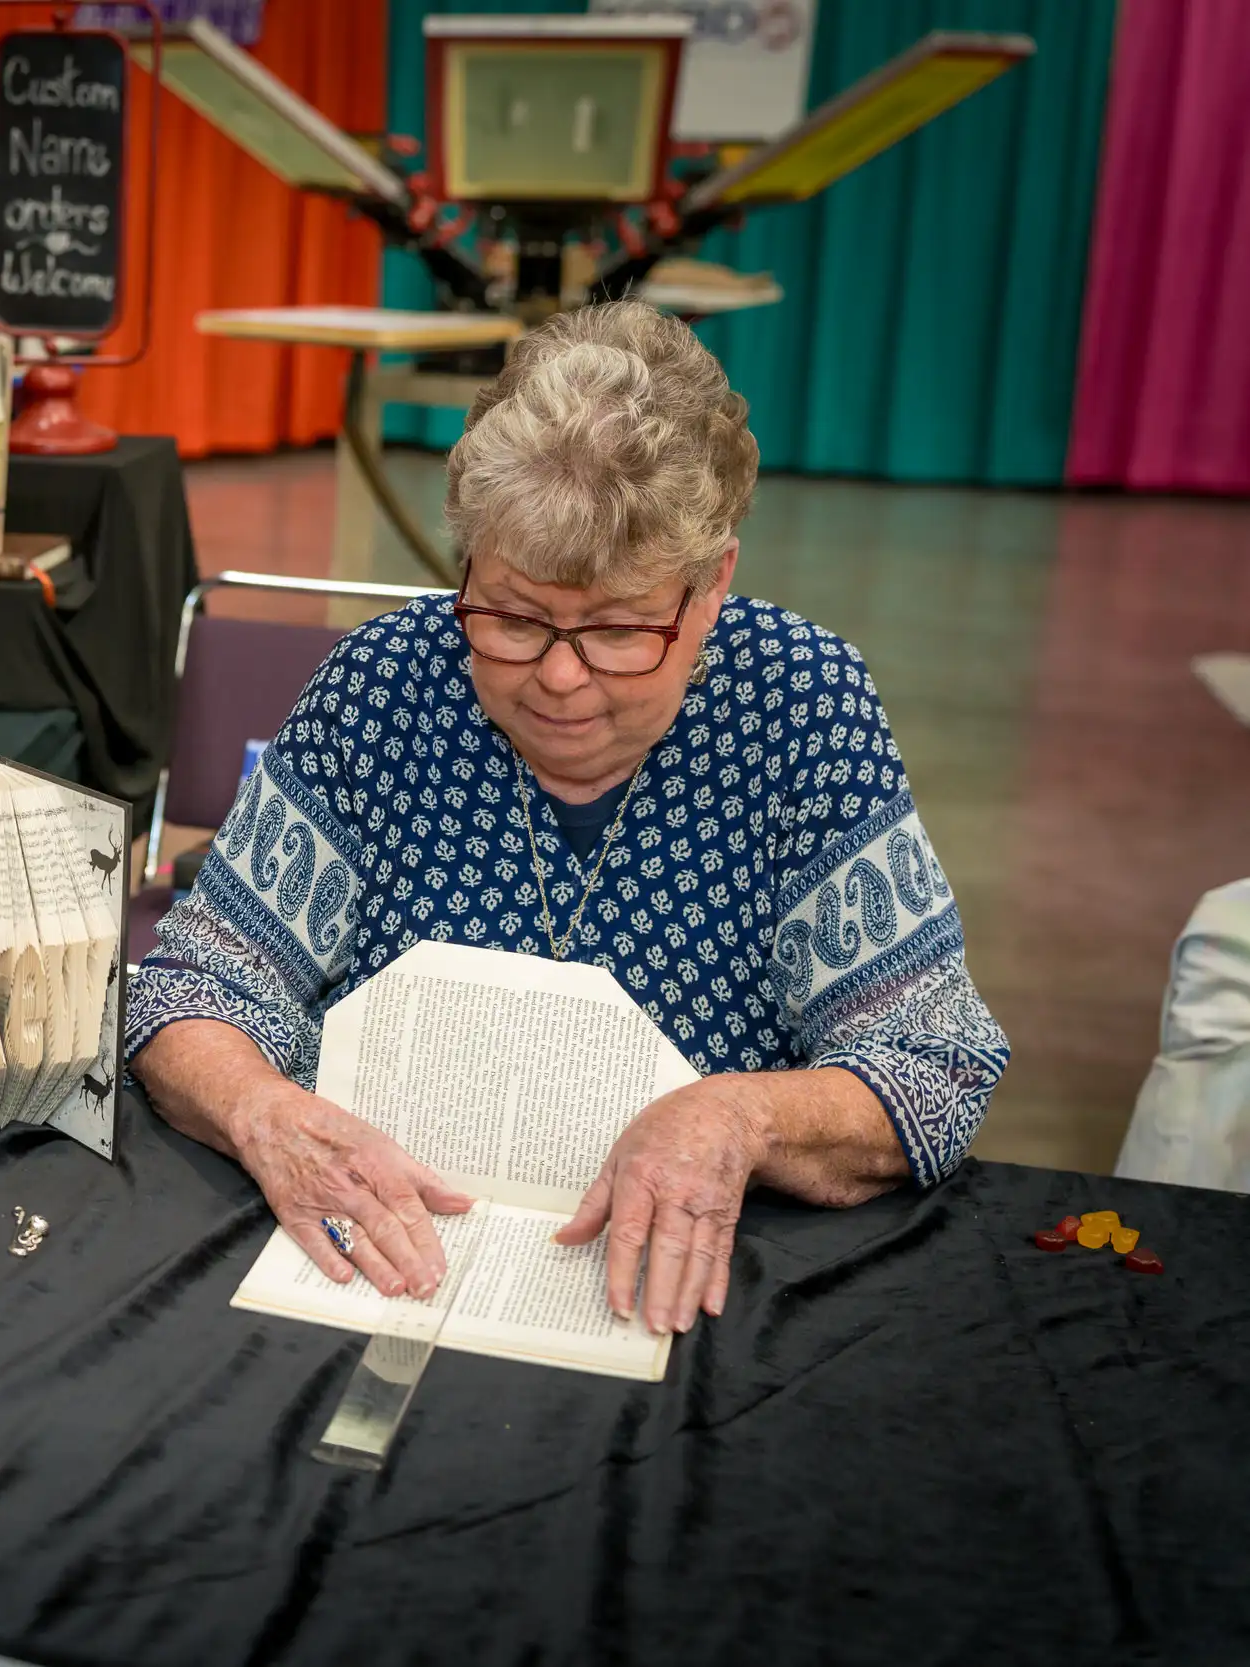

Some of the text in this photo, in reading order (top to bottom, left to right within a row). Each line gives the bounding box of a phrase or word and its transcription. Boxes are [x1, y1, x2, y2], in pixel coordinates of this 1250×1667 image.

[3, 53, 120, 114] Custom
[8, 116, 112, 177] Name
[0, 250, 116, 302] Welcome
